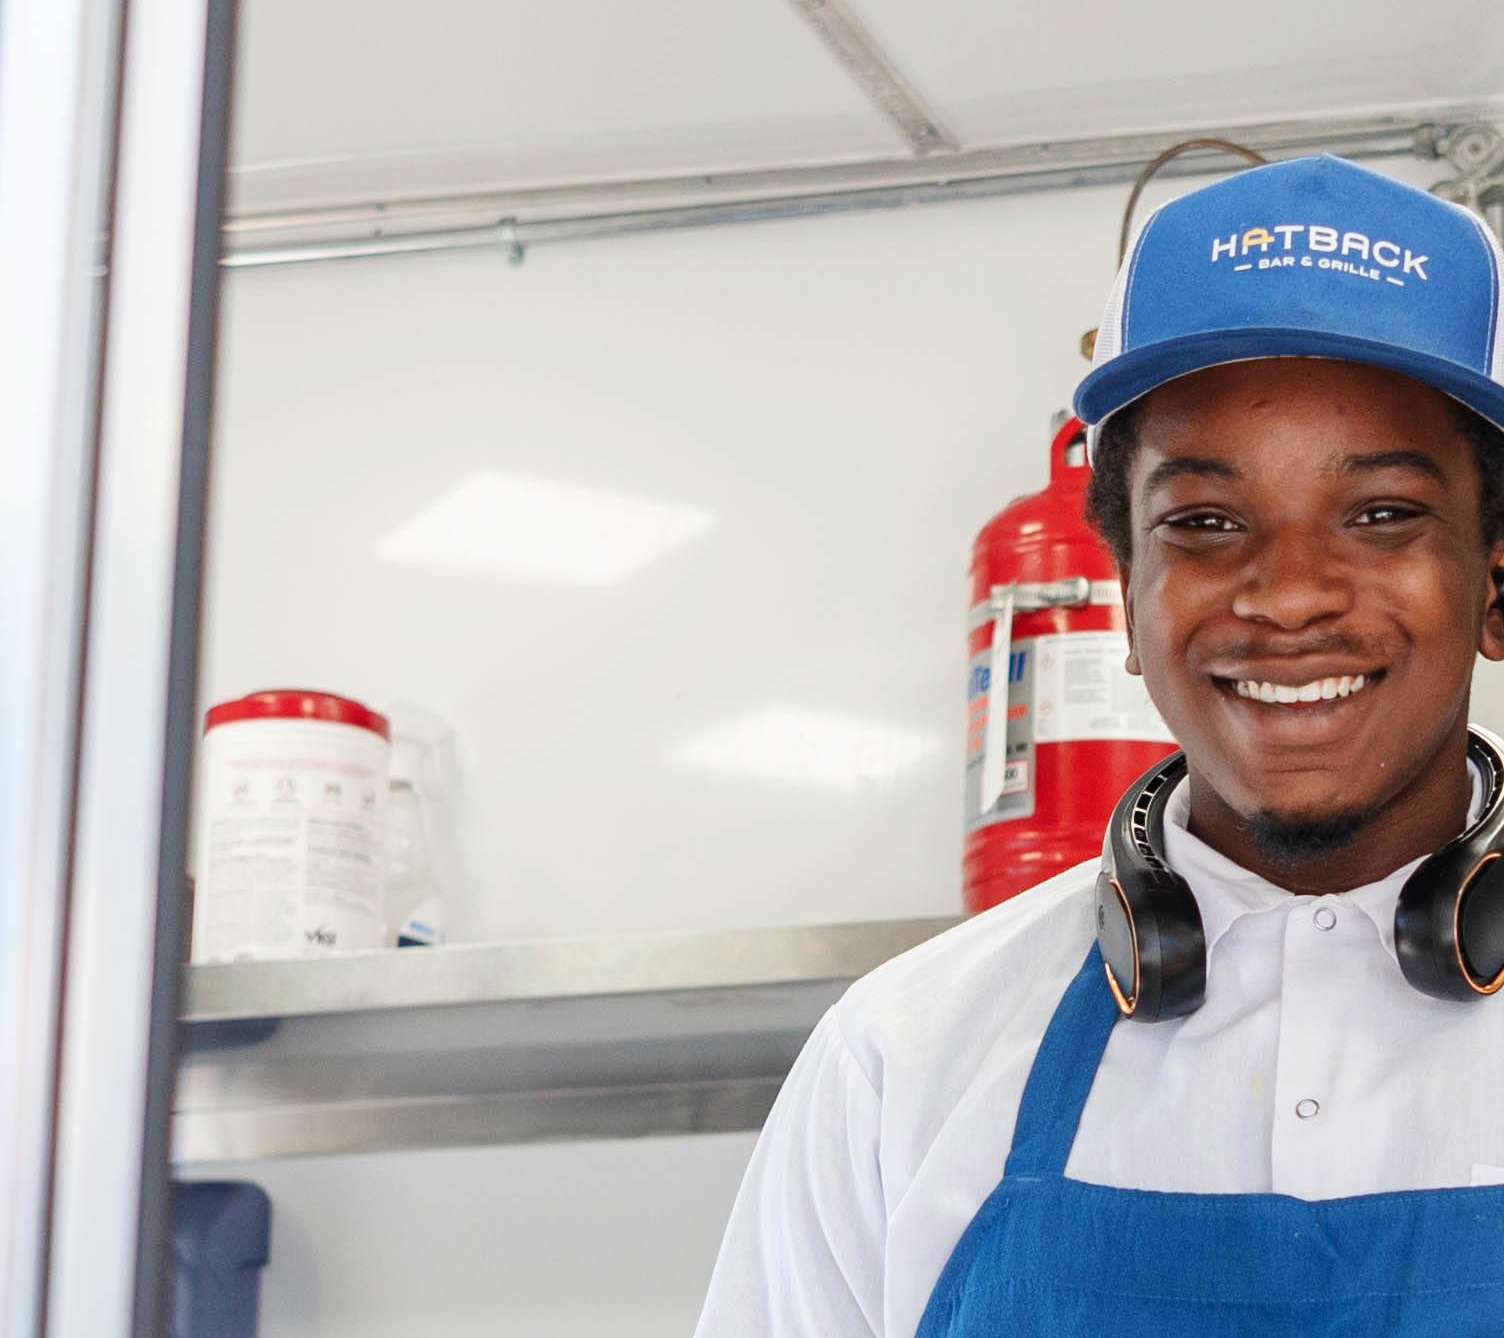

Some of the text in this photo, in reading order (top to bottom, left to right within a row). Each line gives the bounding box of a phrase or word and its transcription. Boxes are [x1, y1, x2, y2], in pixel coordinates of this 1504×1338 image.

[1211, 224, 1429, 280] HATBACK
[1258, 256, 1381, 281] BAR & GRILLE
